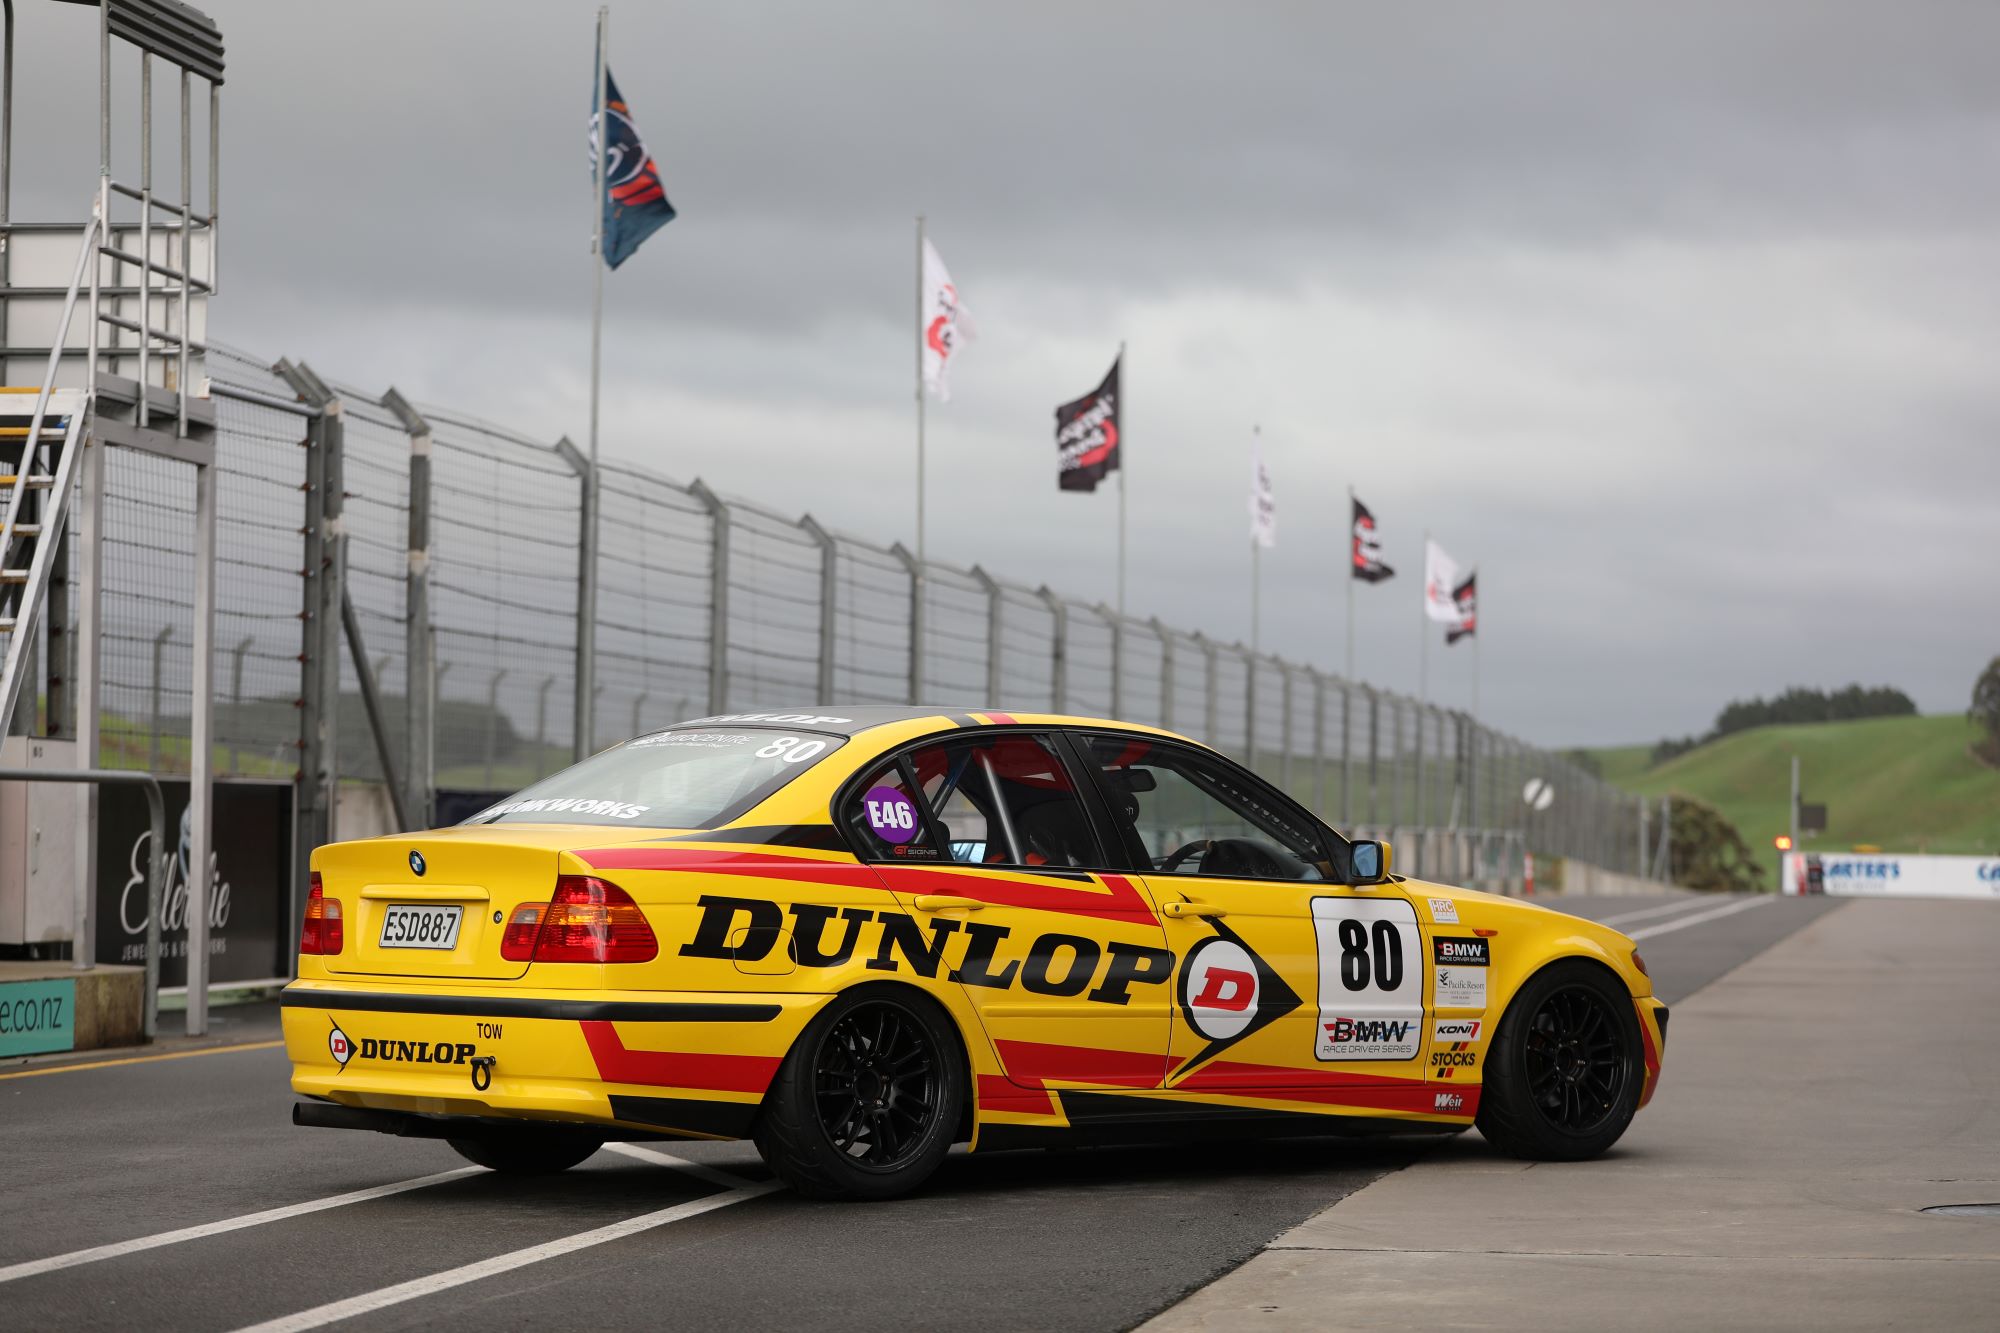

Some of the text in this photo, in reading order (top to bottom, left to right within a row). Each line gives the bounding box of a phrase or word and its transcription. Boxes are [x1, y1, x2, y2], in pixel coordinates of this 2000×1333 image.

[755, 736, 826, 763] 80
[480, 798, 651, 820] UNKWORKS
[867, 801, 914, 829] E46
[383, 911, 457, 944] ESD887
[679, 894, 1177, 1006] DUNLOP
[1338, 918, 1404, 992] 80
[1443, 943, 1482, 957] BMW
[1192, 966, 1256, 1012] D
[1448, 980, 1485, 989] Pacific Resort
[476, 1022, 503, 1040] TOW
[1334, 1020, 1409, 1043] BMW
[1437, 1025, 1473, 1034] KONI
[359, 1038, 476, 1065] DUNLOP
[1322, 1044, 1412, 1054] RACE DRIVER SERIES
[1431, 1052, 1476, 1066] STOCKS
[1434, 1093, 1463, 1107] Weir
